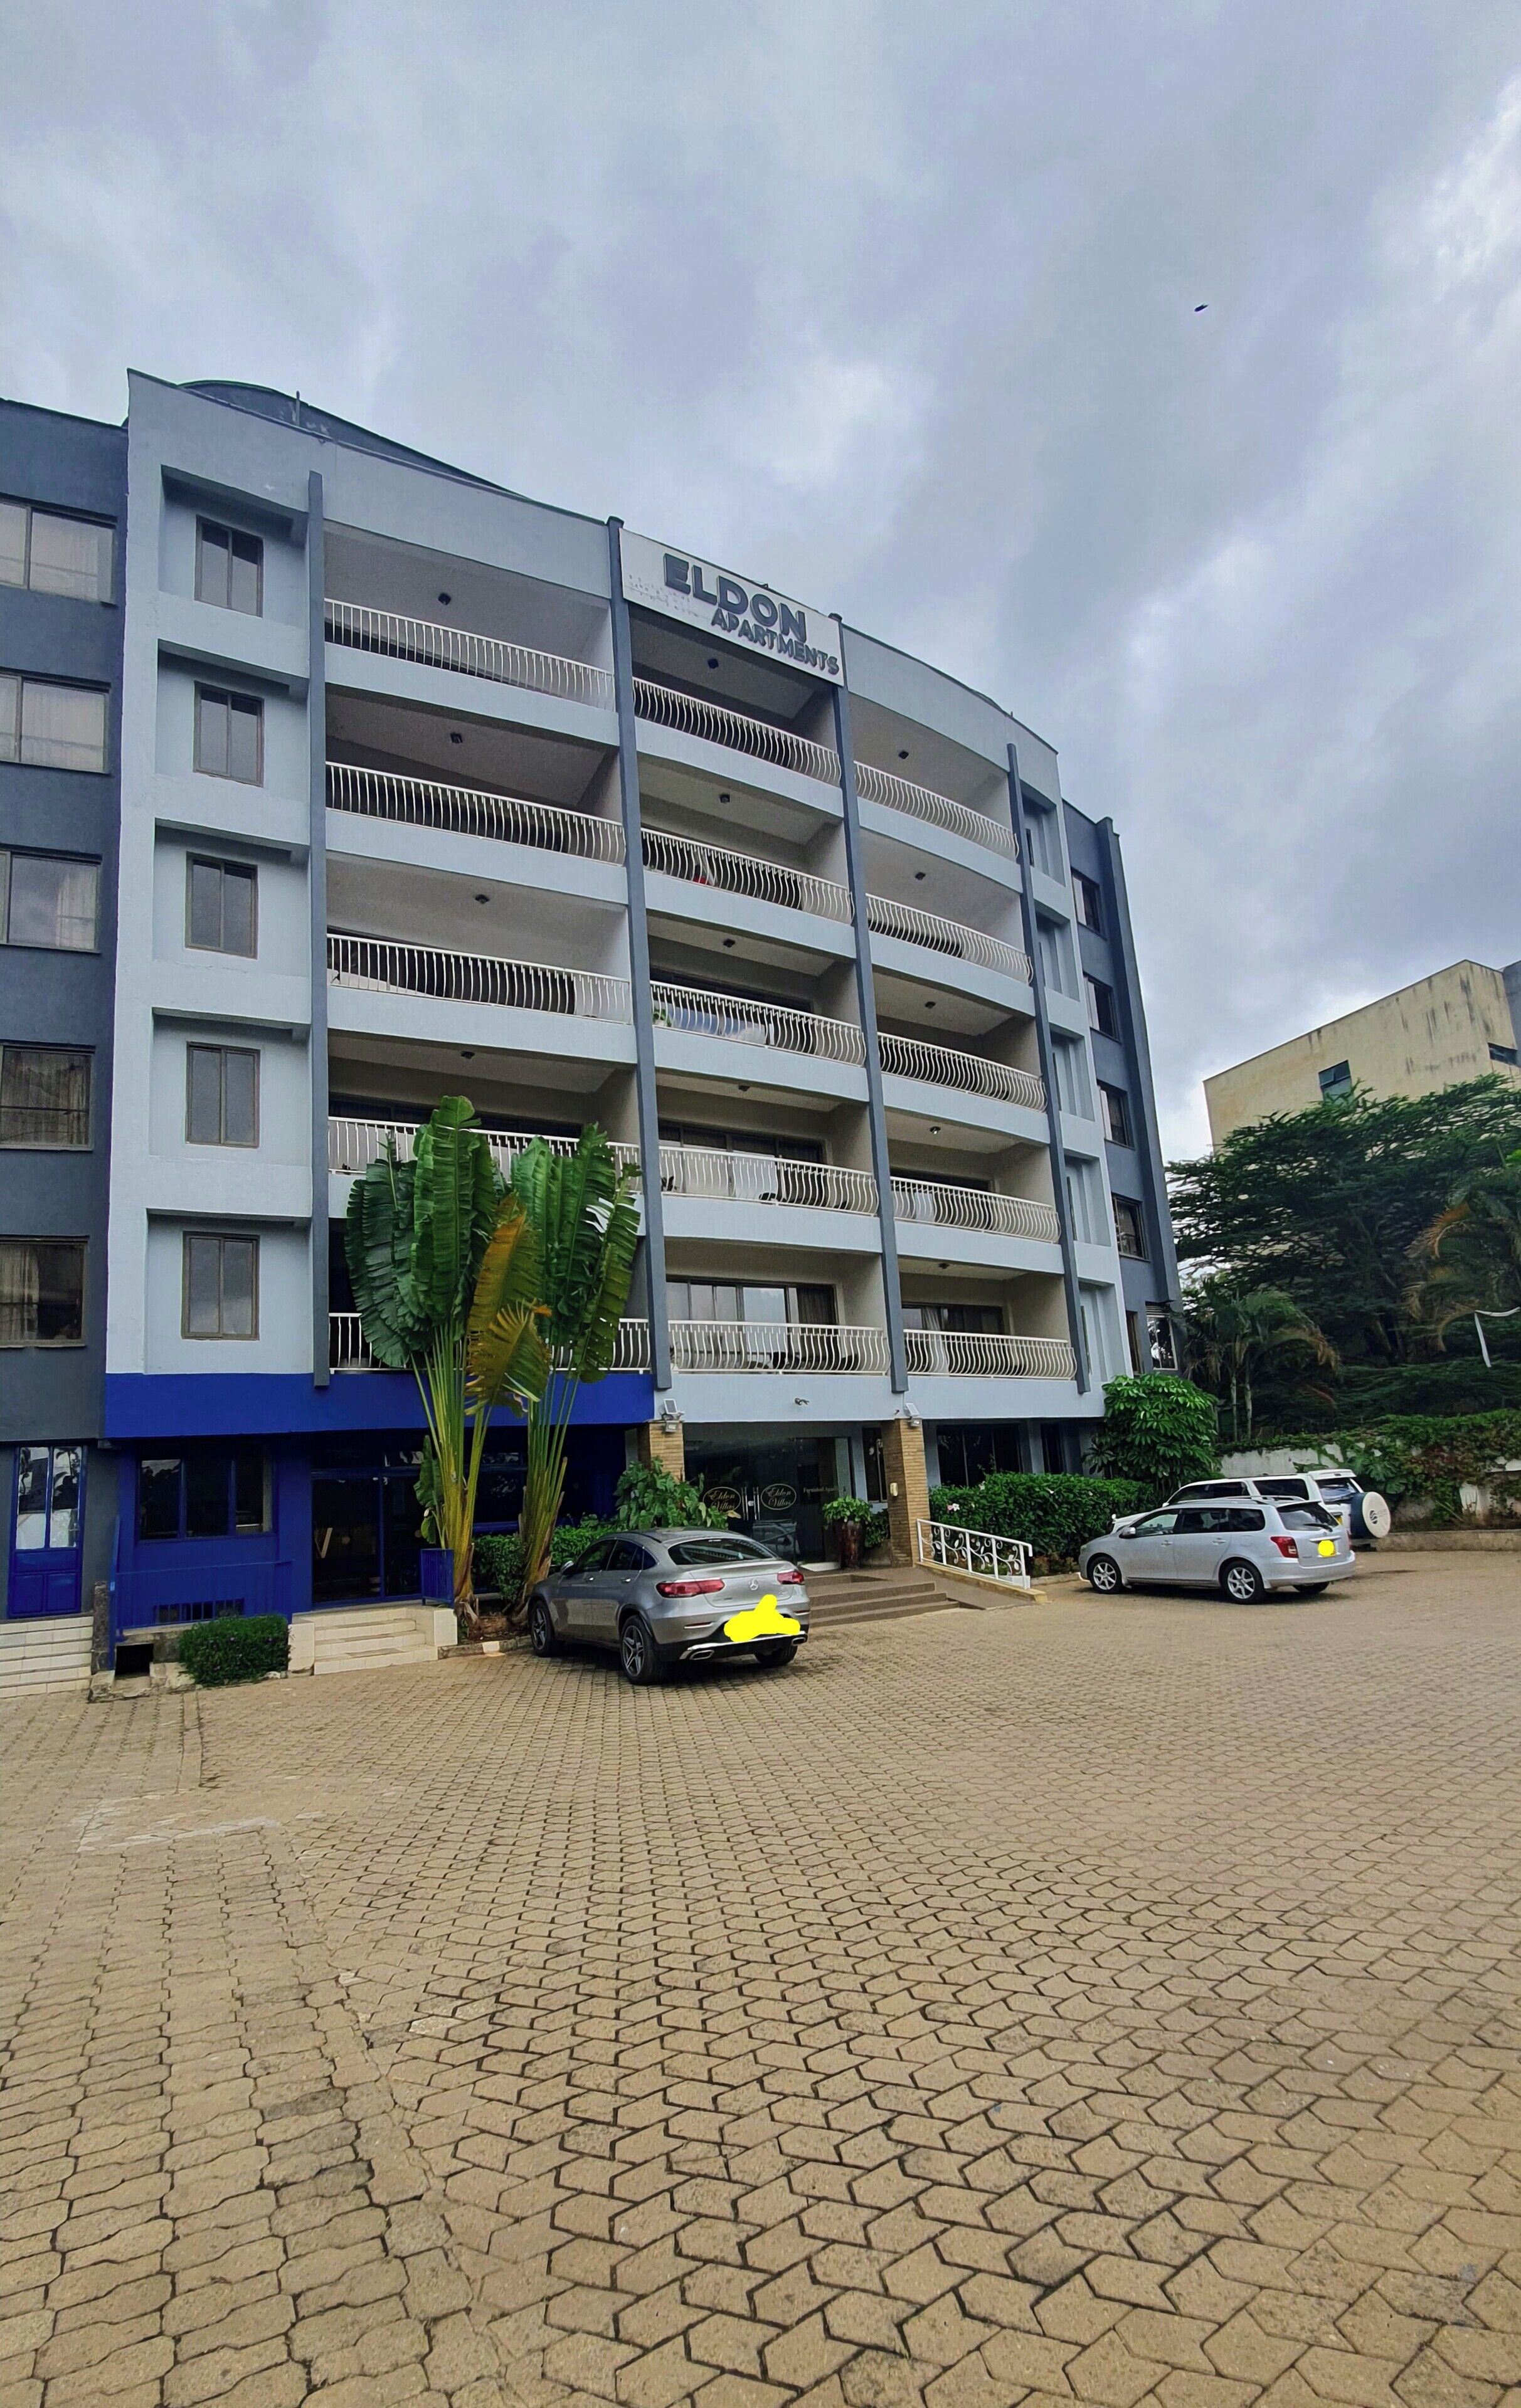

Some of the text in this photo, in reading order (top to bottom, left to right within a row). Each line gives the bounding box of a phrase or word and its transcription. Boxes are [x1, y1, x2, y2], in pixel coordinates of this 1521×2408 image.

[663, 552, 807, 643] ELDON
[711, 608, 840, 675] APARTMENTS
[708, 1490, 735, 1501] Eldon
[766, 1487, 792, 1497] Eldon
[768, 1497, 792, 1507] Villas
